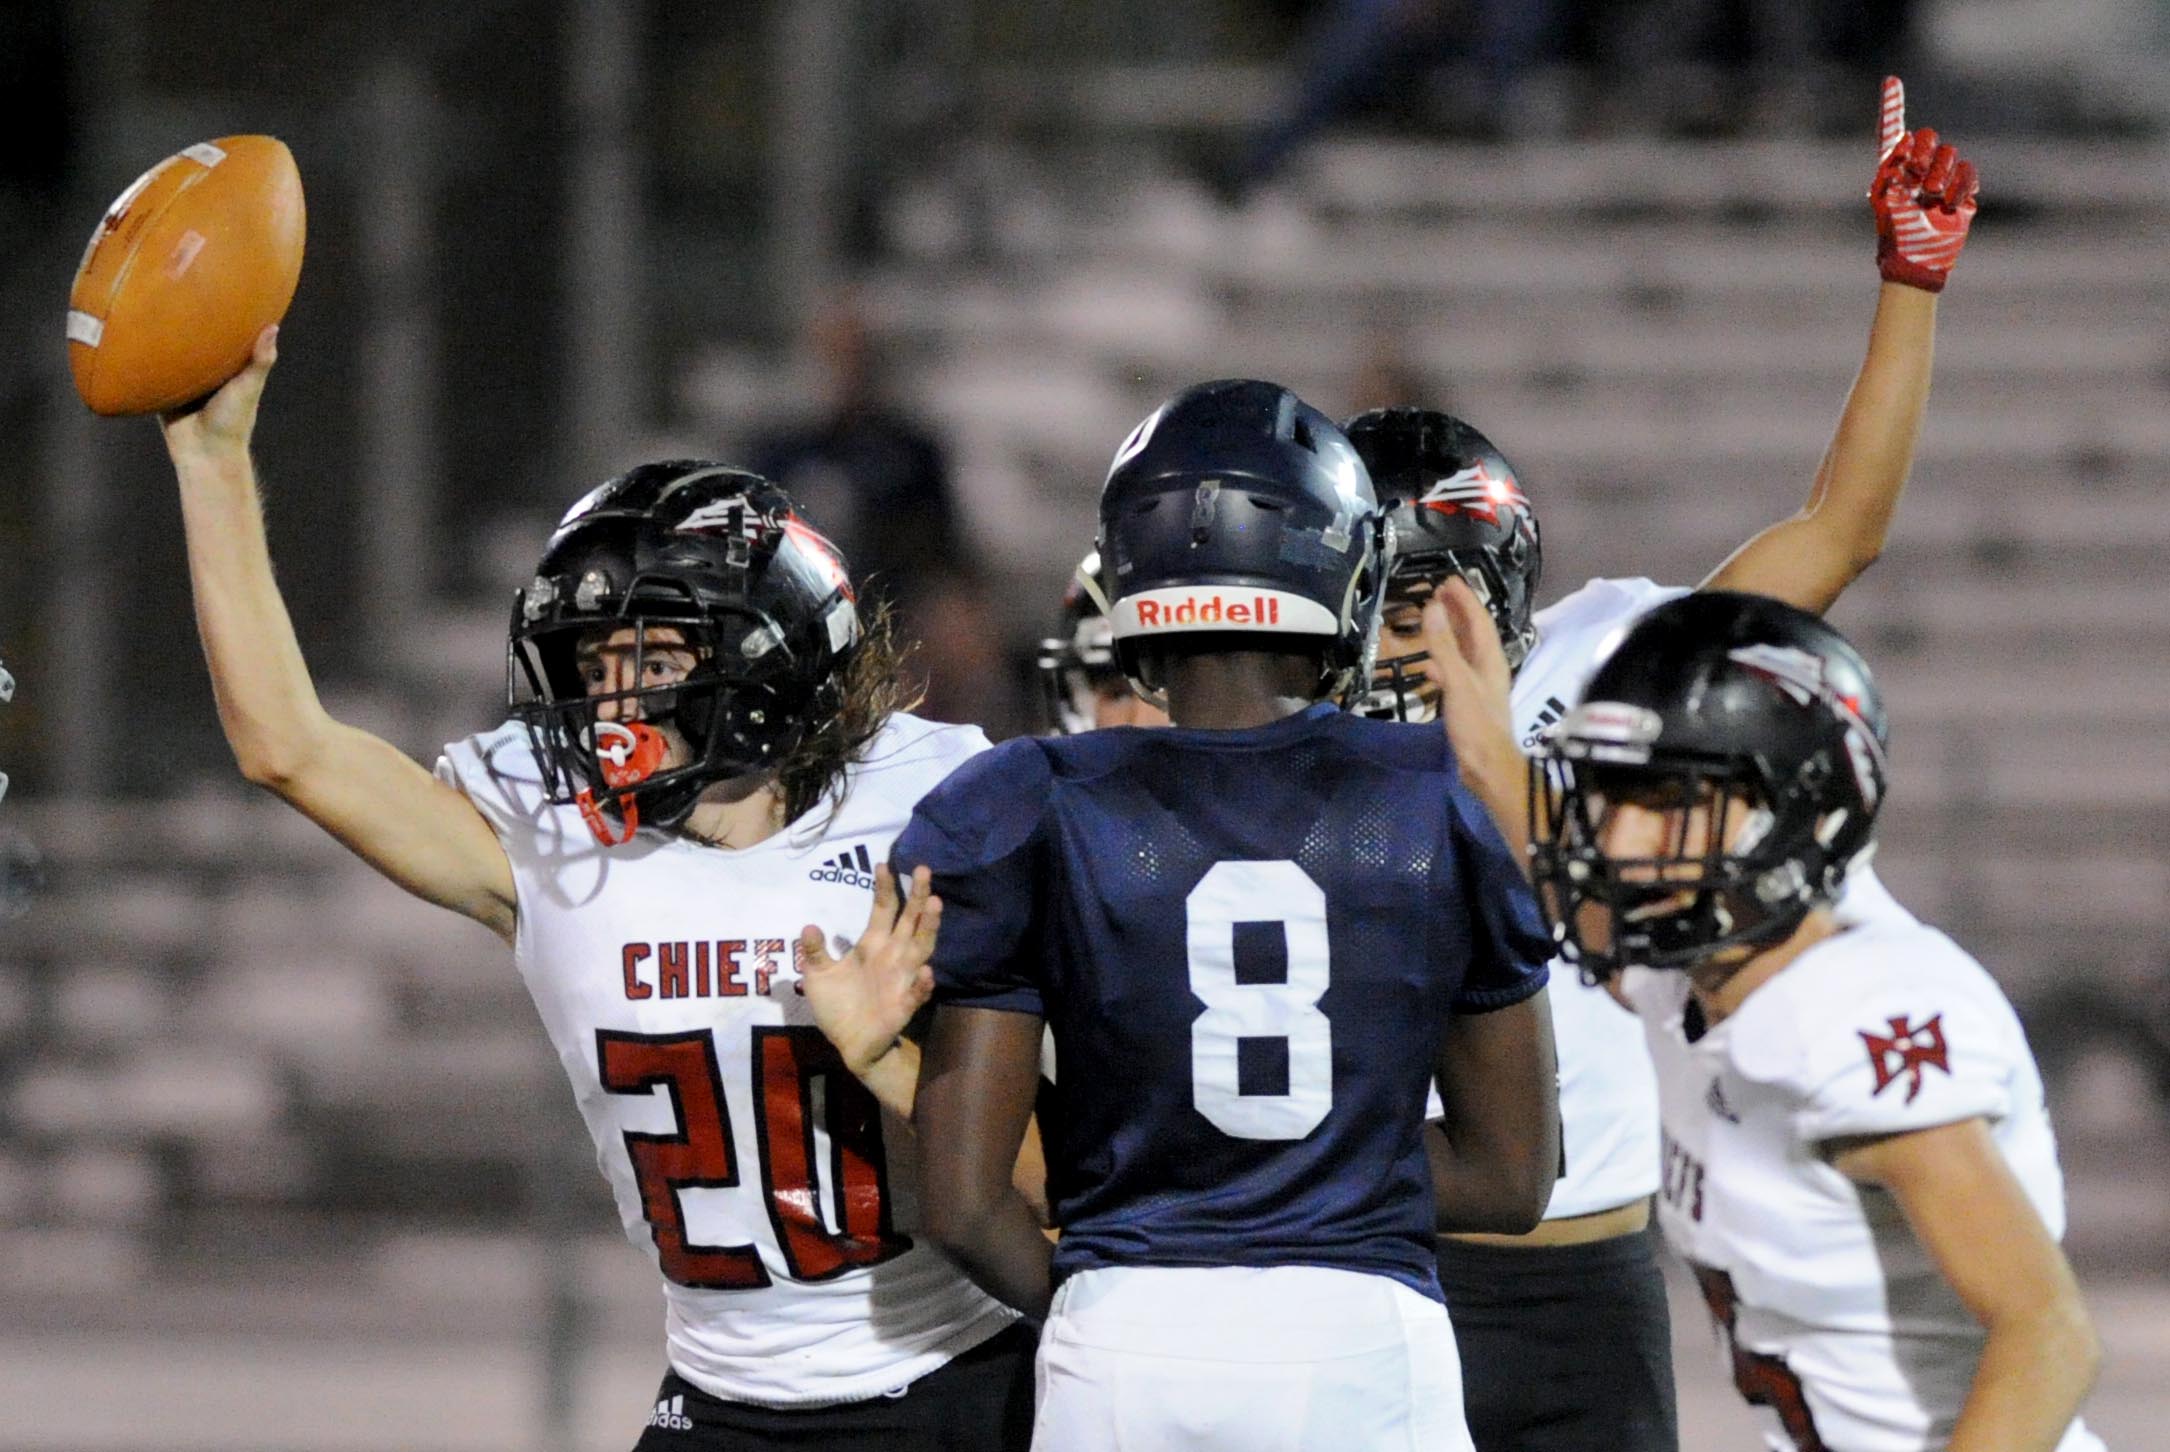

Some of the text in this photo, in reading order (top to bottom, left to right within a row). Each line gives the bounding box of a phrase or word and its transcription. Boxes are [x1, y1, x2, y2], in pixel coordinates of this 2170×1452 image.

[1137, 597, 1279, 627] Riddell
[1186, 860, 1333, 1140] 8
[596, 1025, 913, 1288] 20
